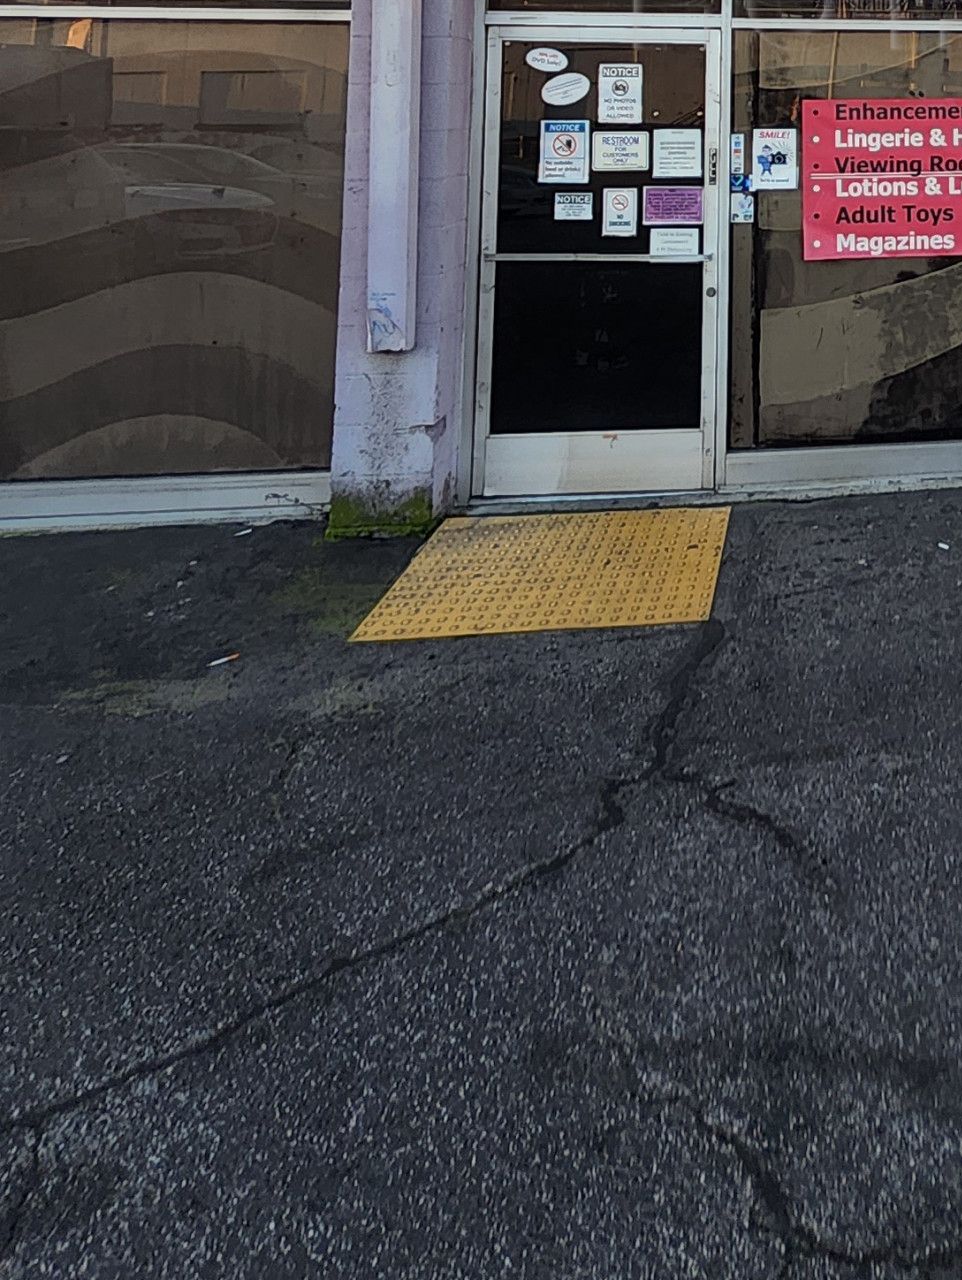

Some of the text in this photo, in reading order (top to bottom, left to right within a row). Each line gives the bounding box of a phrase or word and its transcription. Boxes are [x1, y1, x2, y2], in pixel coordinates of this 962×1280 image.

[603, 67, 639, 77] NOTICE
[549, 123, 581, 132] NOTICE
[759, 131, 790, 139] SMILE!
[835, 128, 924, 152] Lingerie
[929, 128, 948, 147] &
[835, 156, 923, 177] Viewing
[835, 178, 919, 197] Lotions
[924, 177, 943, 196] &
[557, 195, 591, 204] NOTICE
[835, 205, 954, 225] Adult Toys
[836, 231, 955, 256] Magazines
